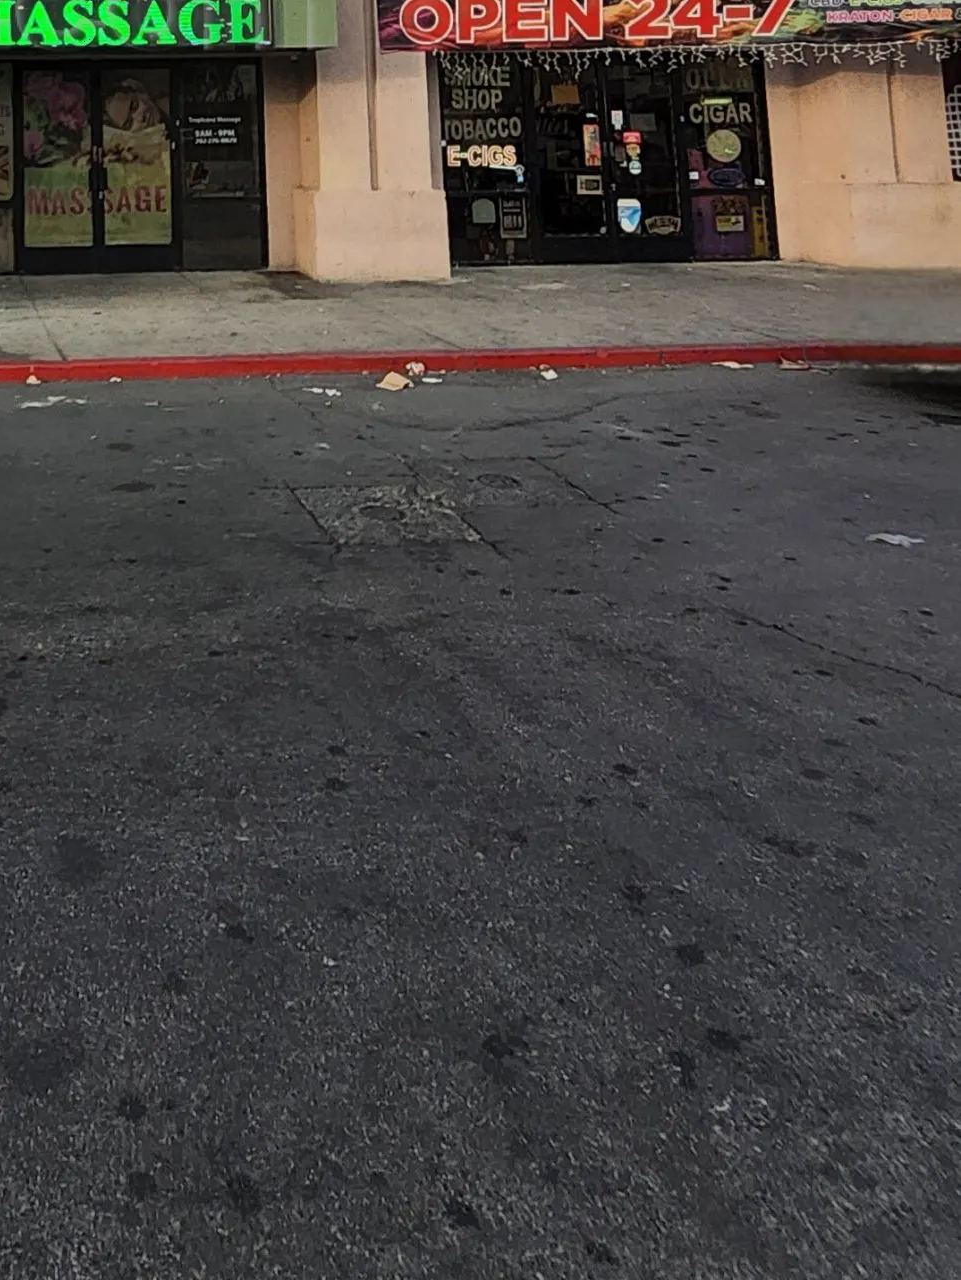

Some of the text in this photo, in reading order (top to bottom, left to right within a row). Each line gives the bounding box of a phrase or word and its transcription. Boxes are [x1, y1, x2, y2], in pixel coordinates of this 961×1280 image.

[901, 8, 954, 22] CIGAR
[444, 66, 511, 87] SMOKE
[451, 88, 503, 110] SHOP
[689, 103, 752, 124] CIGAR
[444, 116, 522, 141] TOBACCO
[447, 144, 517, 167] E-CIGS
